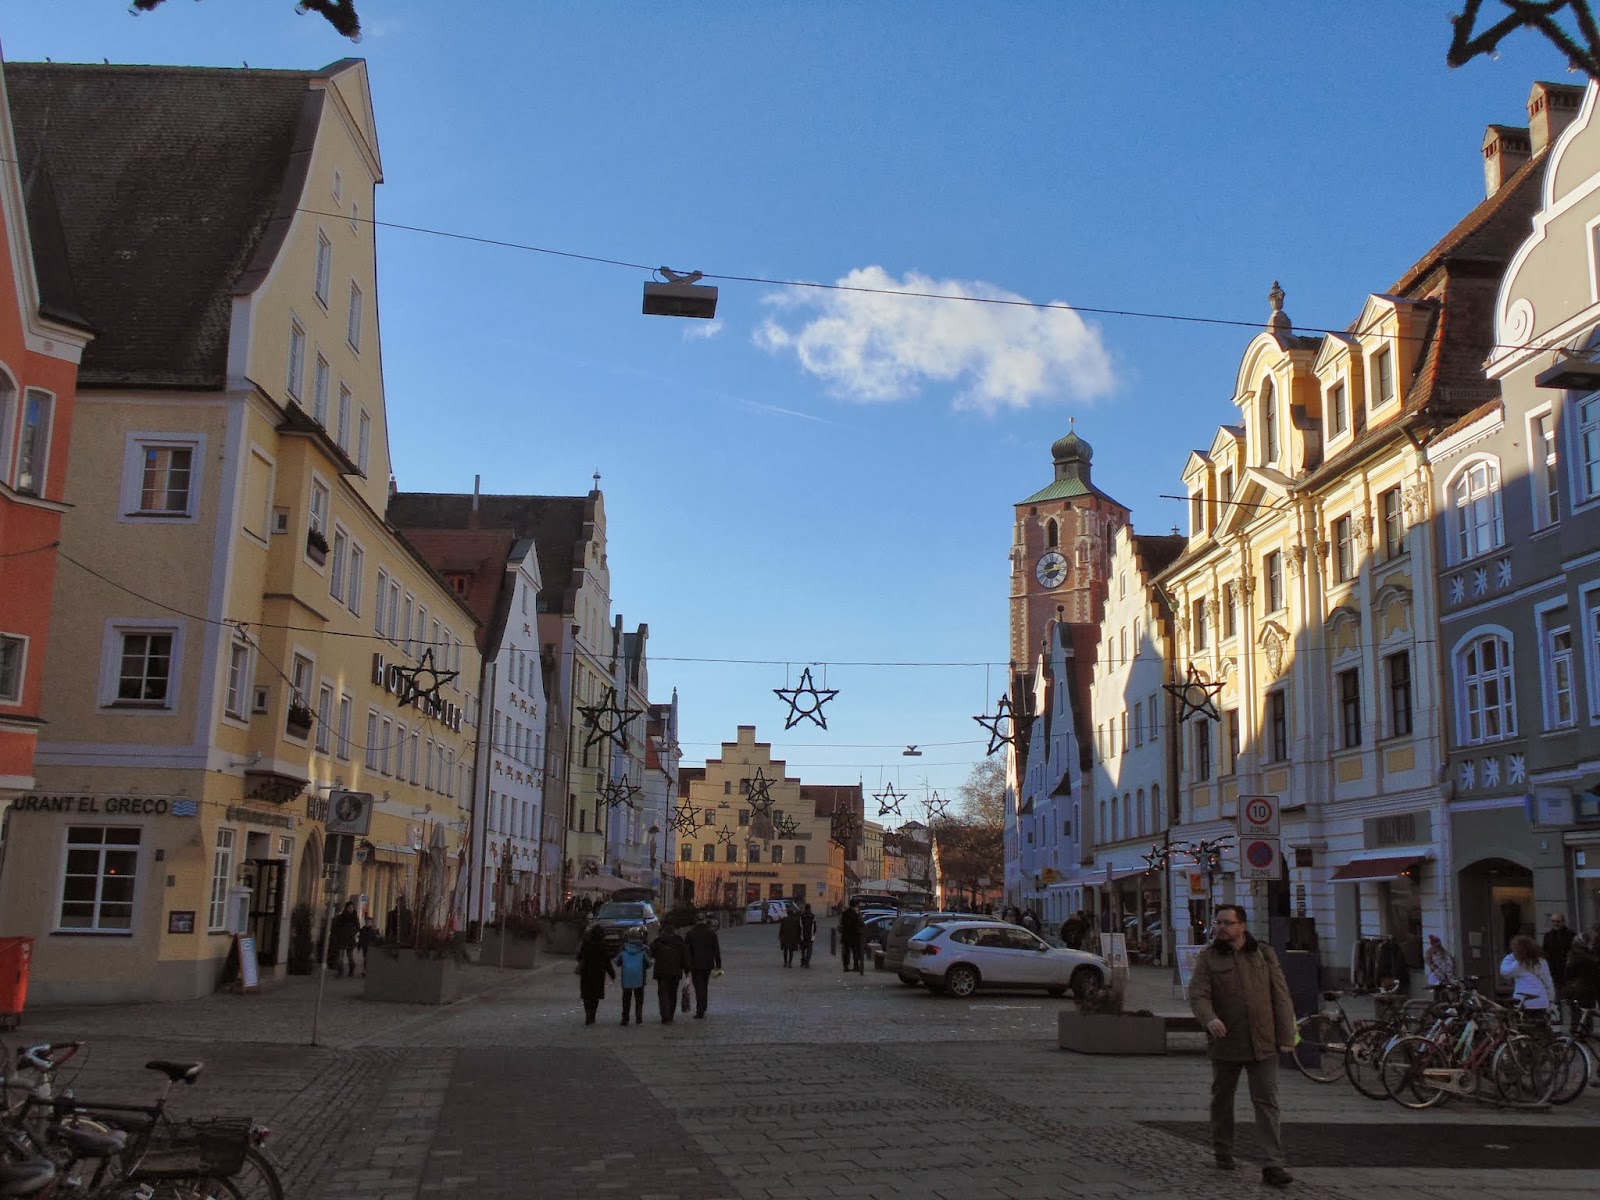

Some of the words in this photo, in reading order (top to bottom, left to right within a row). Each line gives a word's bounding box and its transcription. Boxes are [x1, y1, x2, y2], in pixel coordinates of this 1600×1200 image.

[11, 796, 75, 812] URANT
[78, 797, 99, 812] EL
[105, 798, 168, 814] GRECO
[1252, 805, 1266, 818] 10
[1249, 826, 1270, 834] ZONE
[1250, 869, 1271, 877] ZONE
